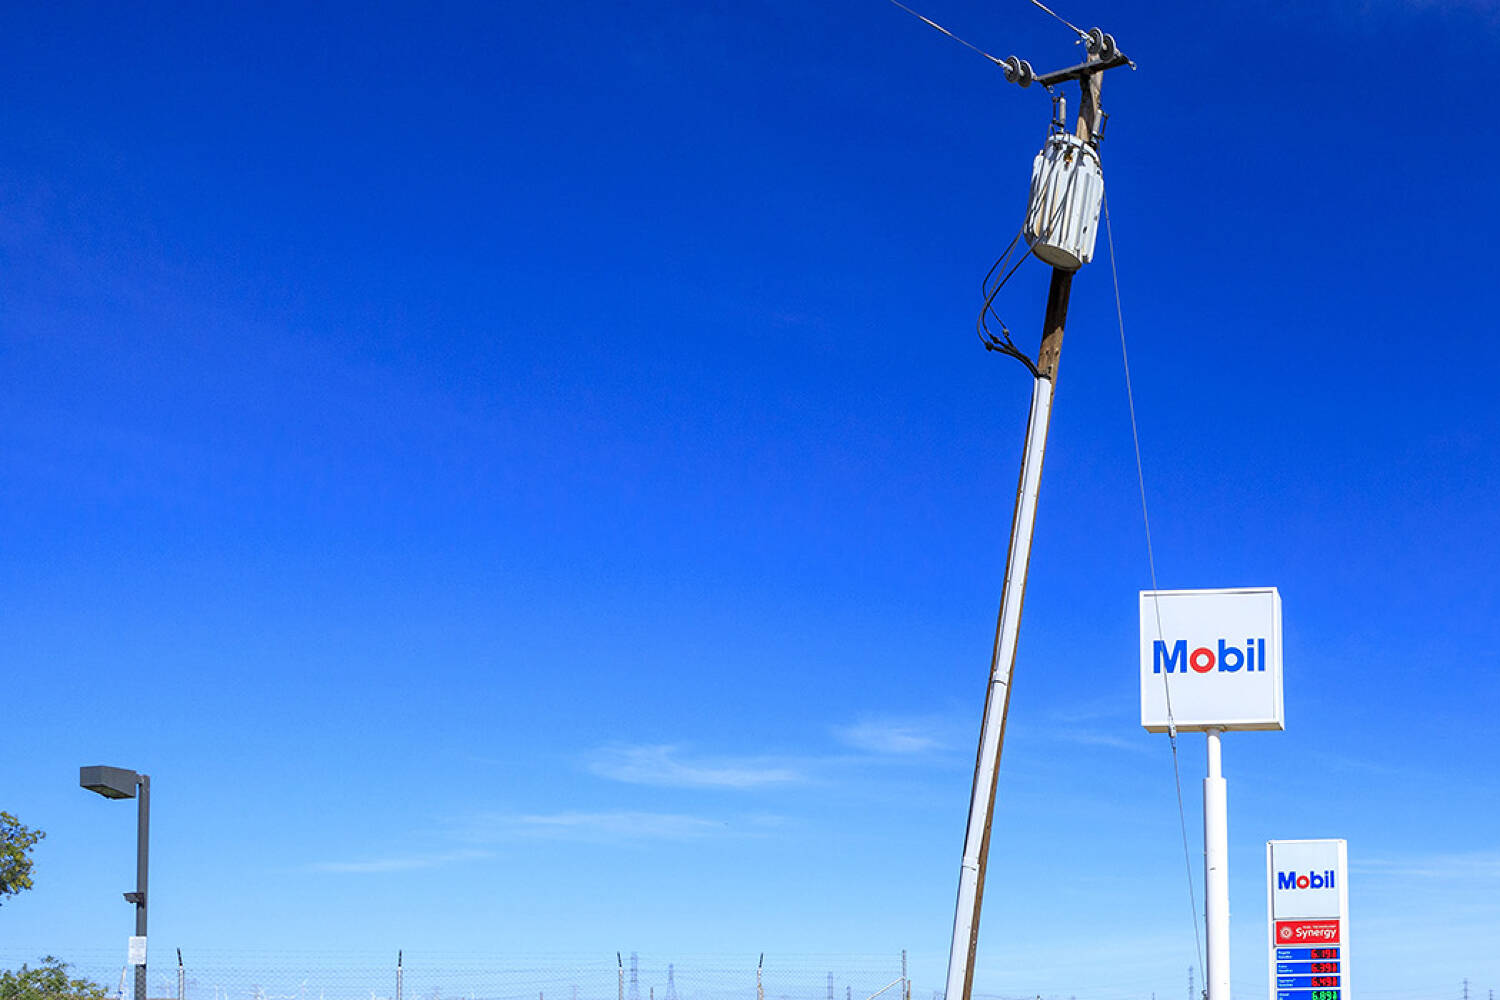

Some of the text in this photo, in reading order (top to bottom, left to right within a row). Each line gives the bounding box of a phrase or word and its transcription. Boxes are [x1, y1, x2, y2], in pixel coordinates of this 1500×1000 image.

[1153, 638, 1265, 674] Mobil
[1278, 870, 1335, 890] Mobil
[1295, 926, 1337, 939] Synergy
